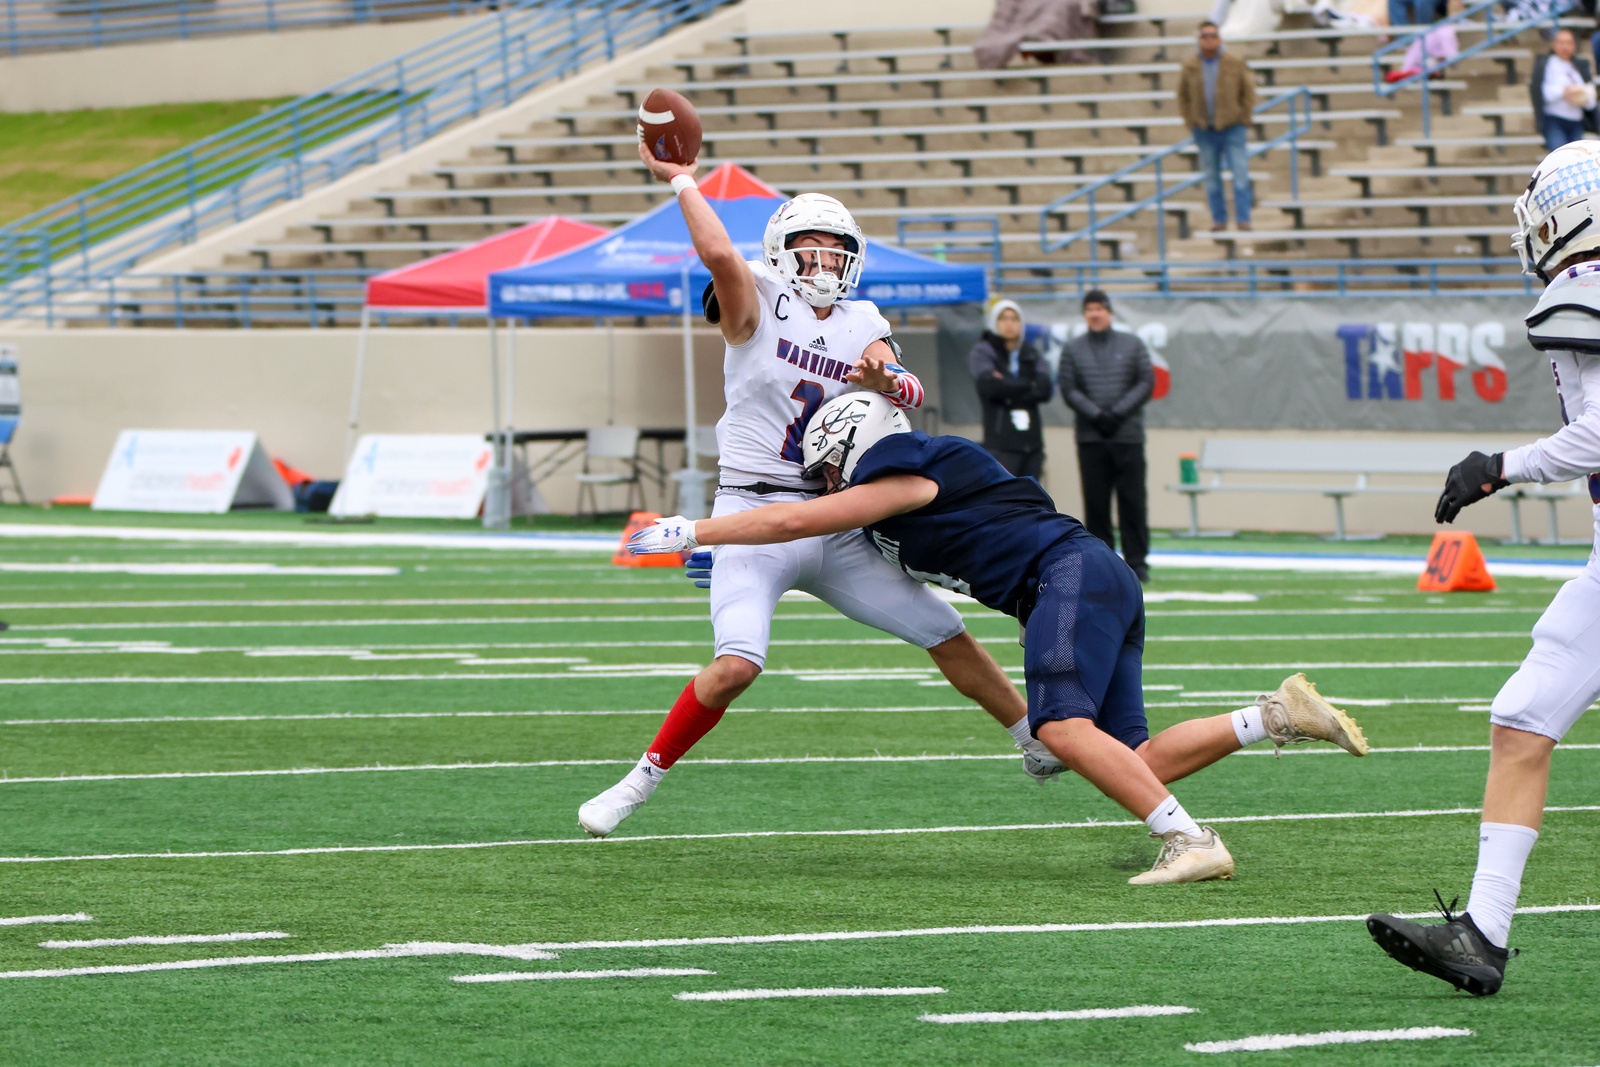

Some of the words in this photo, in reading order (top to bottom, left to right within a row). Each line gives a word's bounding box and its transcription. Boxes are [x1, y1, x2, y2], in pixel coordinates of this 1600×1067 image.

[775, 293, 790, 321] C
[776, 337, 853, 385] WARRIORS
[808, 342, 828, 353] adidas
[1336, 322, 1508, 403] TAPPS
[780, 379, 824, 465] 2
[1427, 540, 1461, 583] 40
